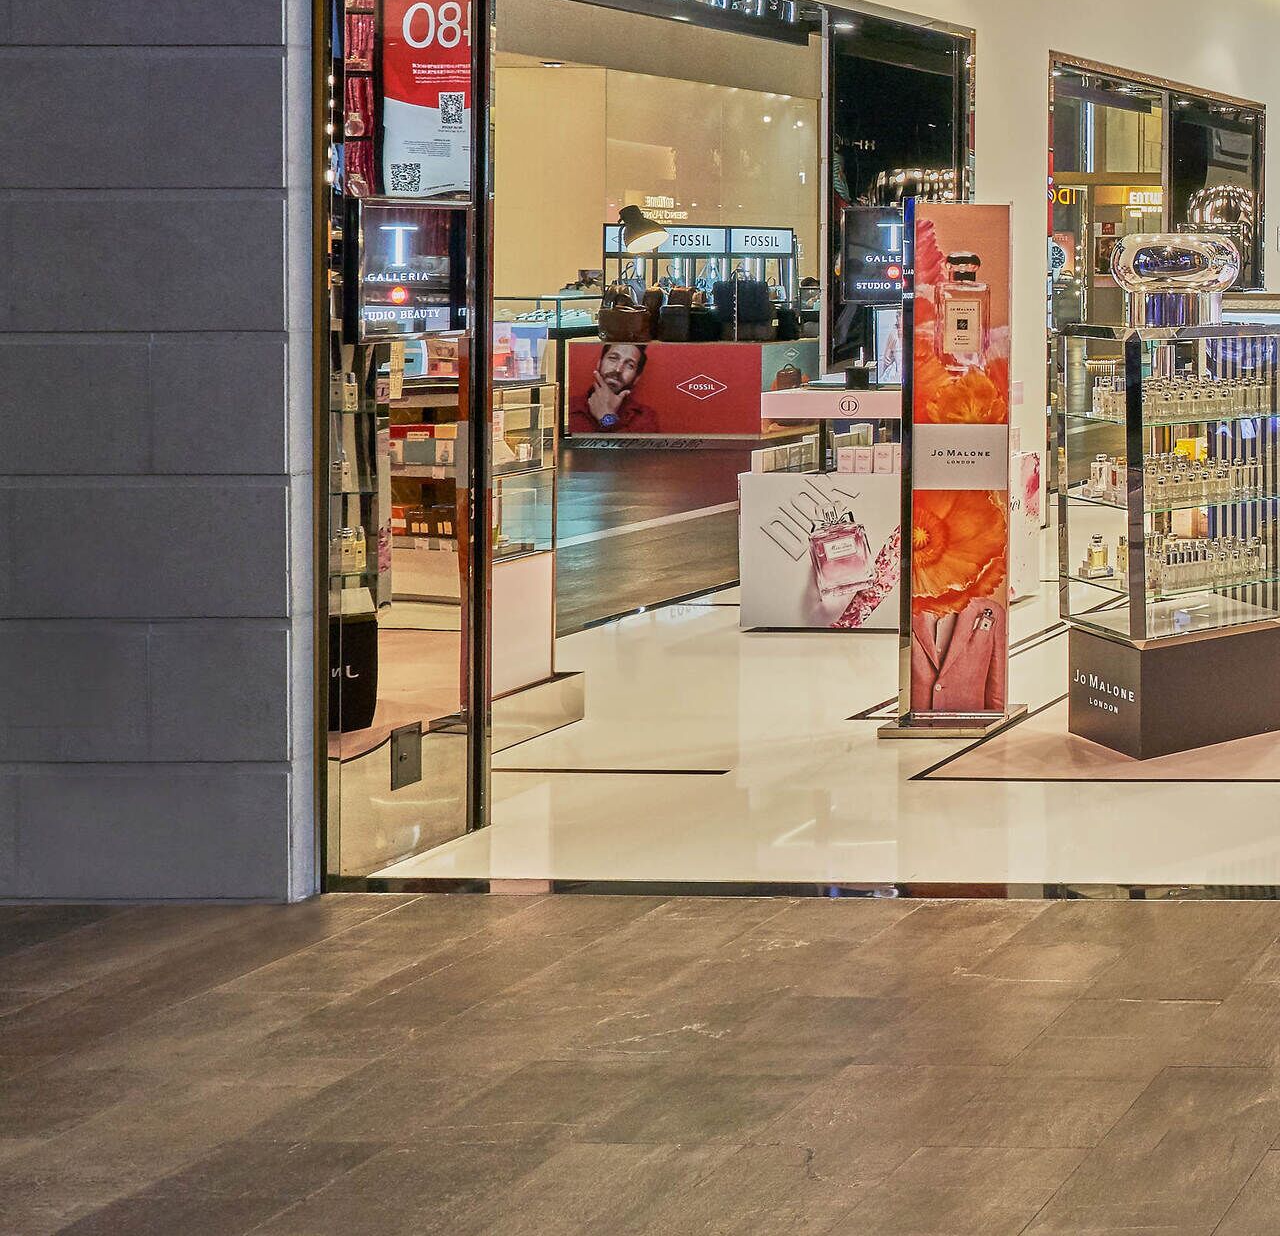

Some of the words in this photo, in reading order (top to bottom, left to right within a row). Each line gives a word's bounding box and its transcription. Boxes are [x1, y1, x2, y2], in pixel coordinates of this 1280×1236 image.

[672, 234, 712, 247] FOSSIL
[744, 235, 780, 247] FOSSIL
[865, 255, 902, 263] GALLE
[367, 272, 430, 282] GALLERIA
[400, 309, 440, 320] BEAUTY
[688, 382, 715, 391] FOSSIL
[946, 449, 991, 457] MALONE
[1073, 668, 1087, 685] JO
[1089, 673, 1135, 702] MALONE
[1089, 697, 1119, 714] LONDON
